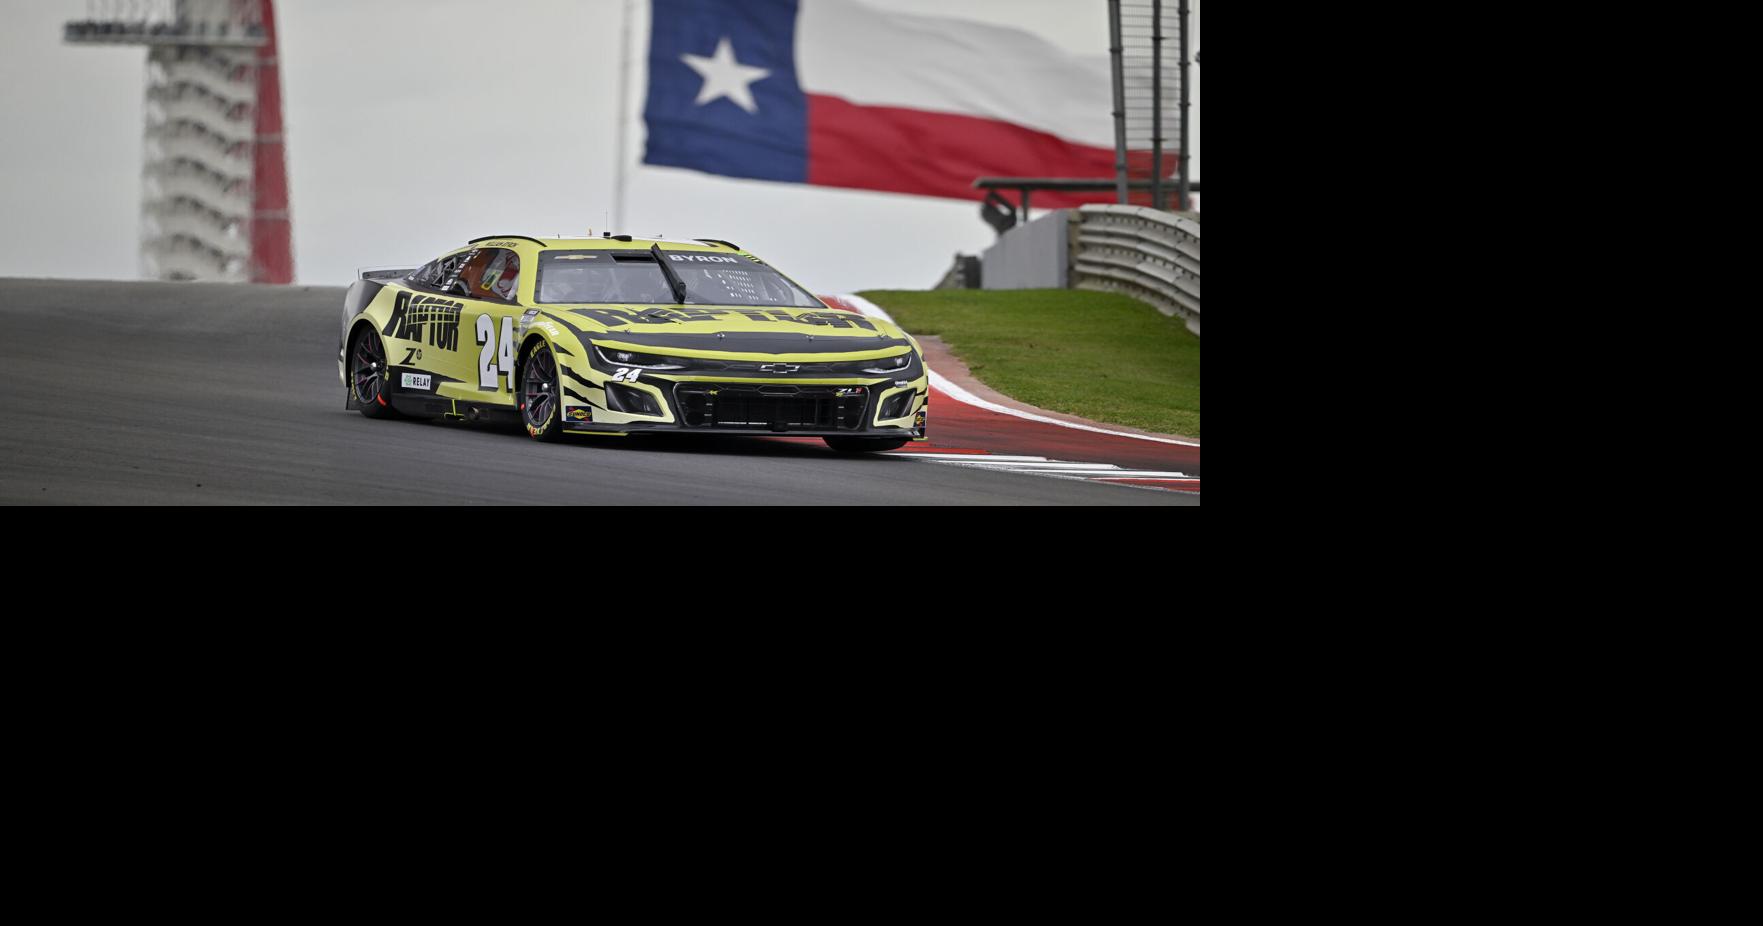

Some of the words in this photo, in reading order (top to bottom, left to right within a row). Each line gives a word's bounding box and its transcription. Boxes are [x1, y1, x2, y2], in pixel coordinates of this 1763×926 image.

[668, 254, 738, 264] BYRON
[382, 290, 464, 352] RAPTOR
[570, 307, 878, 332] RAPTOR
[475, 313, 514, 393] 24
[530, 340, 546, 359] EAGLE
[412, 377, 430, 387] RELAY
[611, 367, 642, 383] 24
